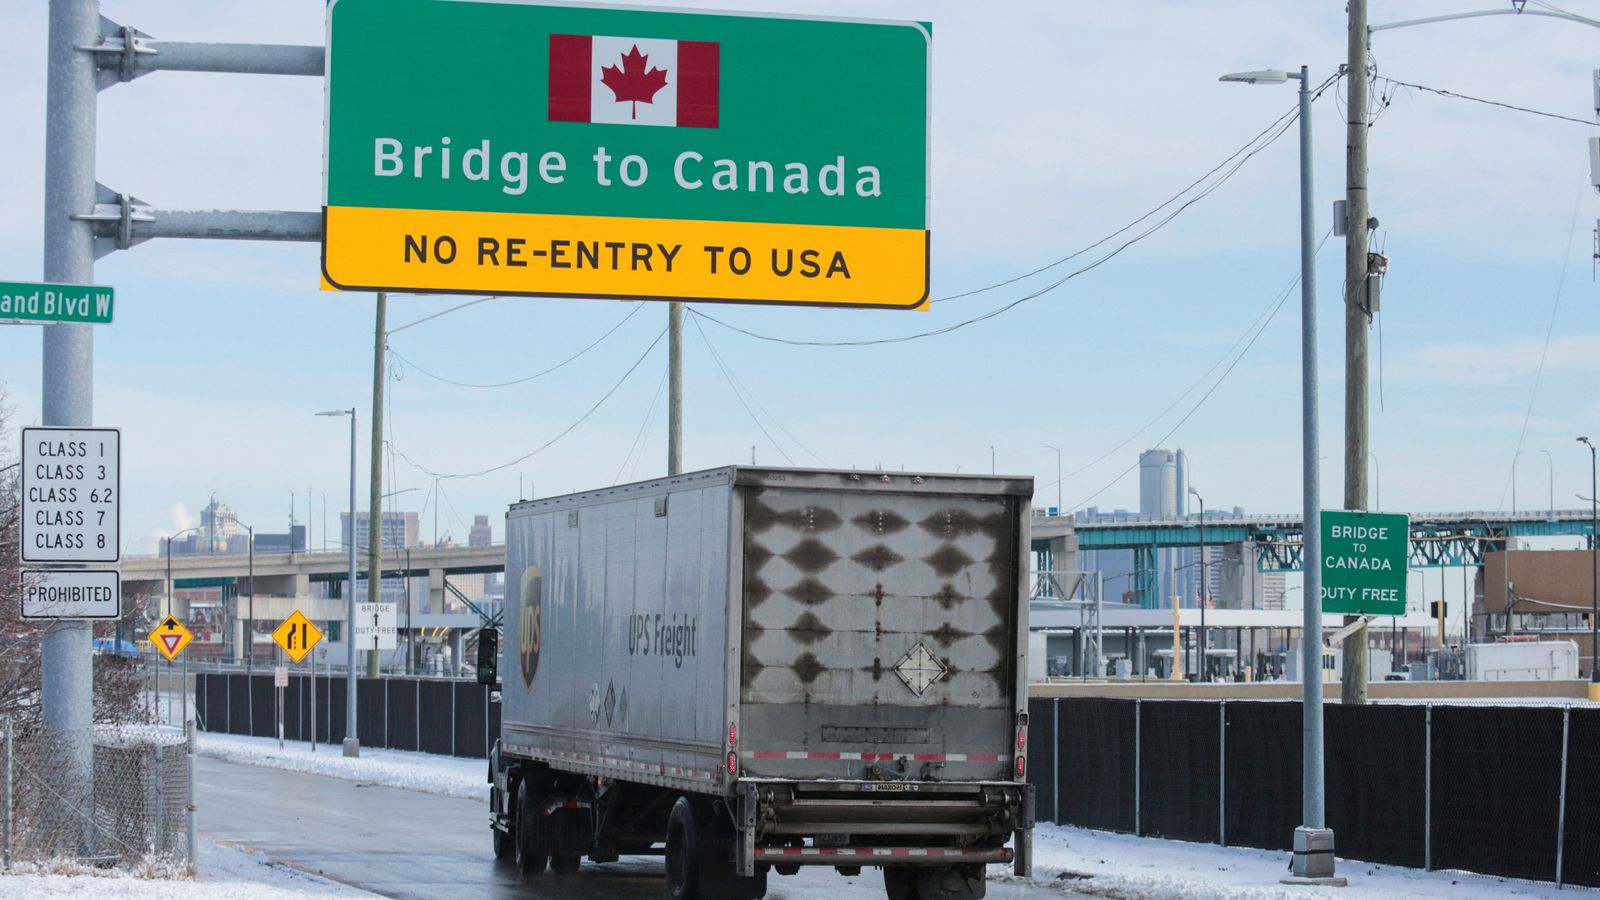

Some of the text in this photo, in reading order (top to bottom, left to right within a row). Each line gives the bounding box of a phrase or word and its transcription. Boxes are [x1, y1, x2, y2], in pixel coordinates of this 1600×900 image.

[374, 136, 881, 198] Bridge to Canada
[404, 234, 851, 279] NO RE-ENTRY TO USA
[0, 291, 111, 317] and Blvd W
[38, 441, 104, 457] CLASS 1
[36, 464, 106, 480] CLASS 3
[29, 487, 113, 503] CLASS 6.2
[36, 510, 105, 526] CLASS 7
[1331, 525, 1389, 540] BRIDGE
[36, 533, 106, 549] CLASS 8
[1352, 543, 1367, 553] TO
[1325, 556, 1392, 571] CANADA
[28, 586, 113, 602] PROHIBITED
[1362, 588, 1399, 602] FREE
[361, 604, 390, 612] BRIDGE
[628, 612, 697, 669] UPS Freight
